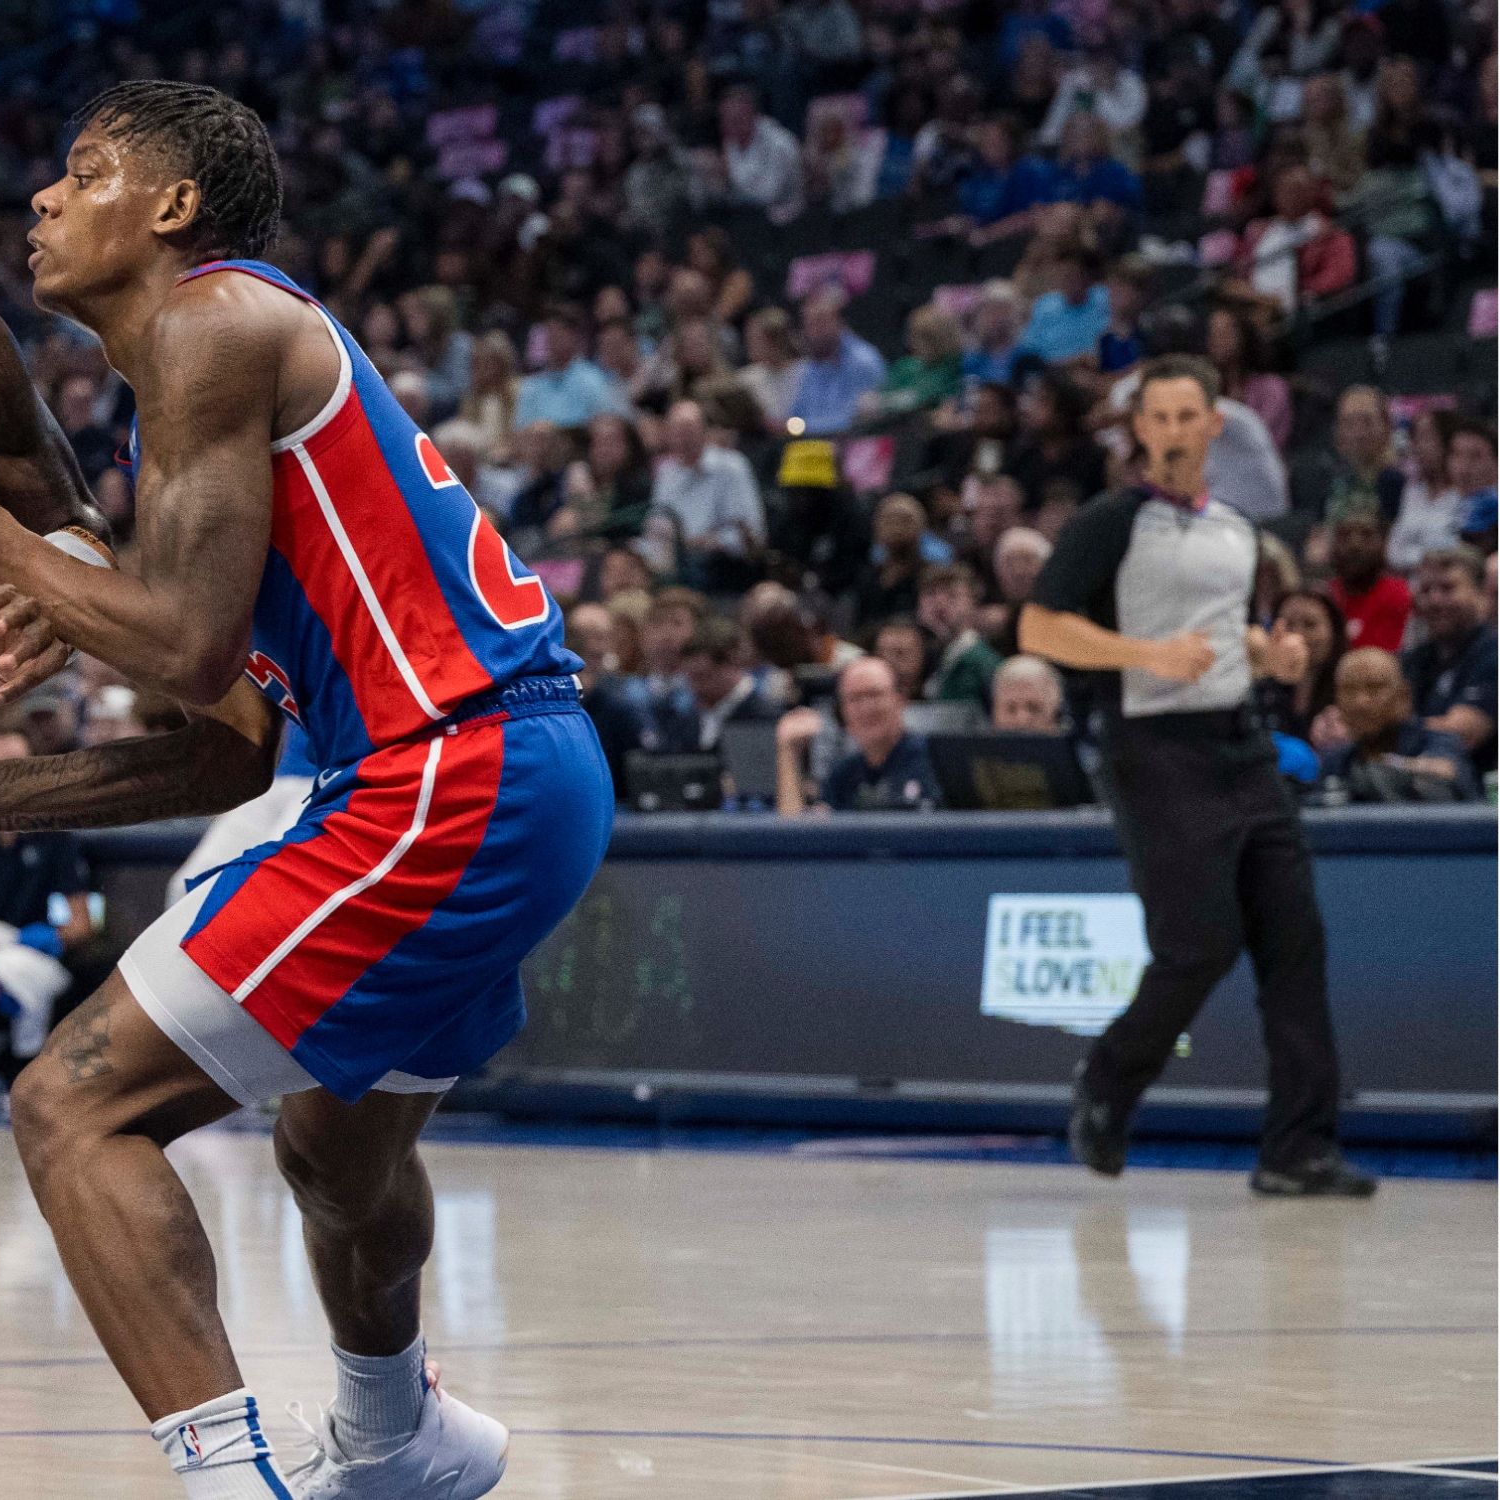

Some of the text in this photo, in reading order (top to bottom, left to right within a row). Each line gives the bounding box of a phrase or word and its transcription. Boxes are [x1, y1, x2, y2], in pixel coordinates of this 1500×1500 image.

[1000, 910, 1092, 948] I FEEL
[996, 958, 1137, 997] SLOVENI
